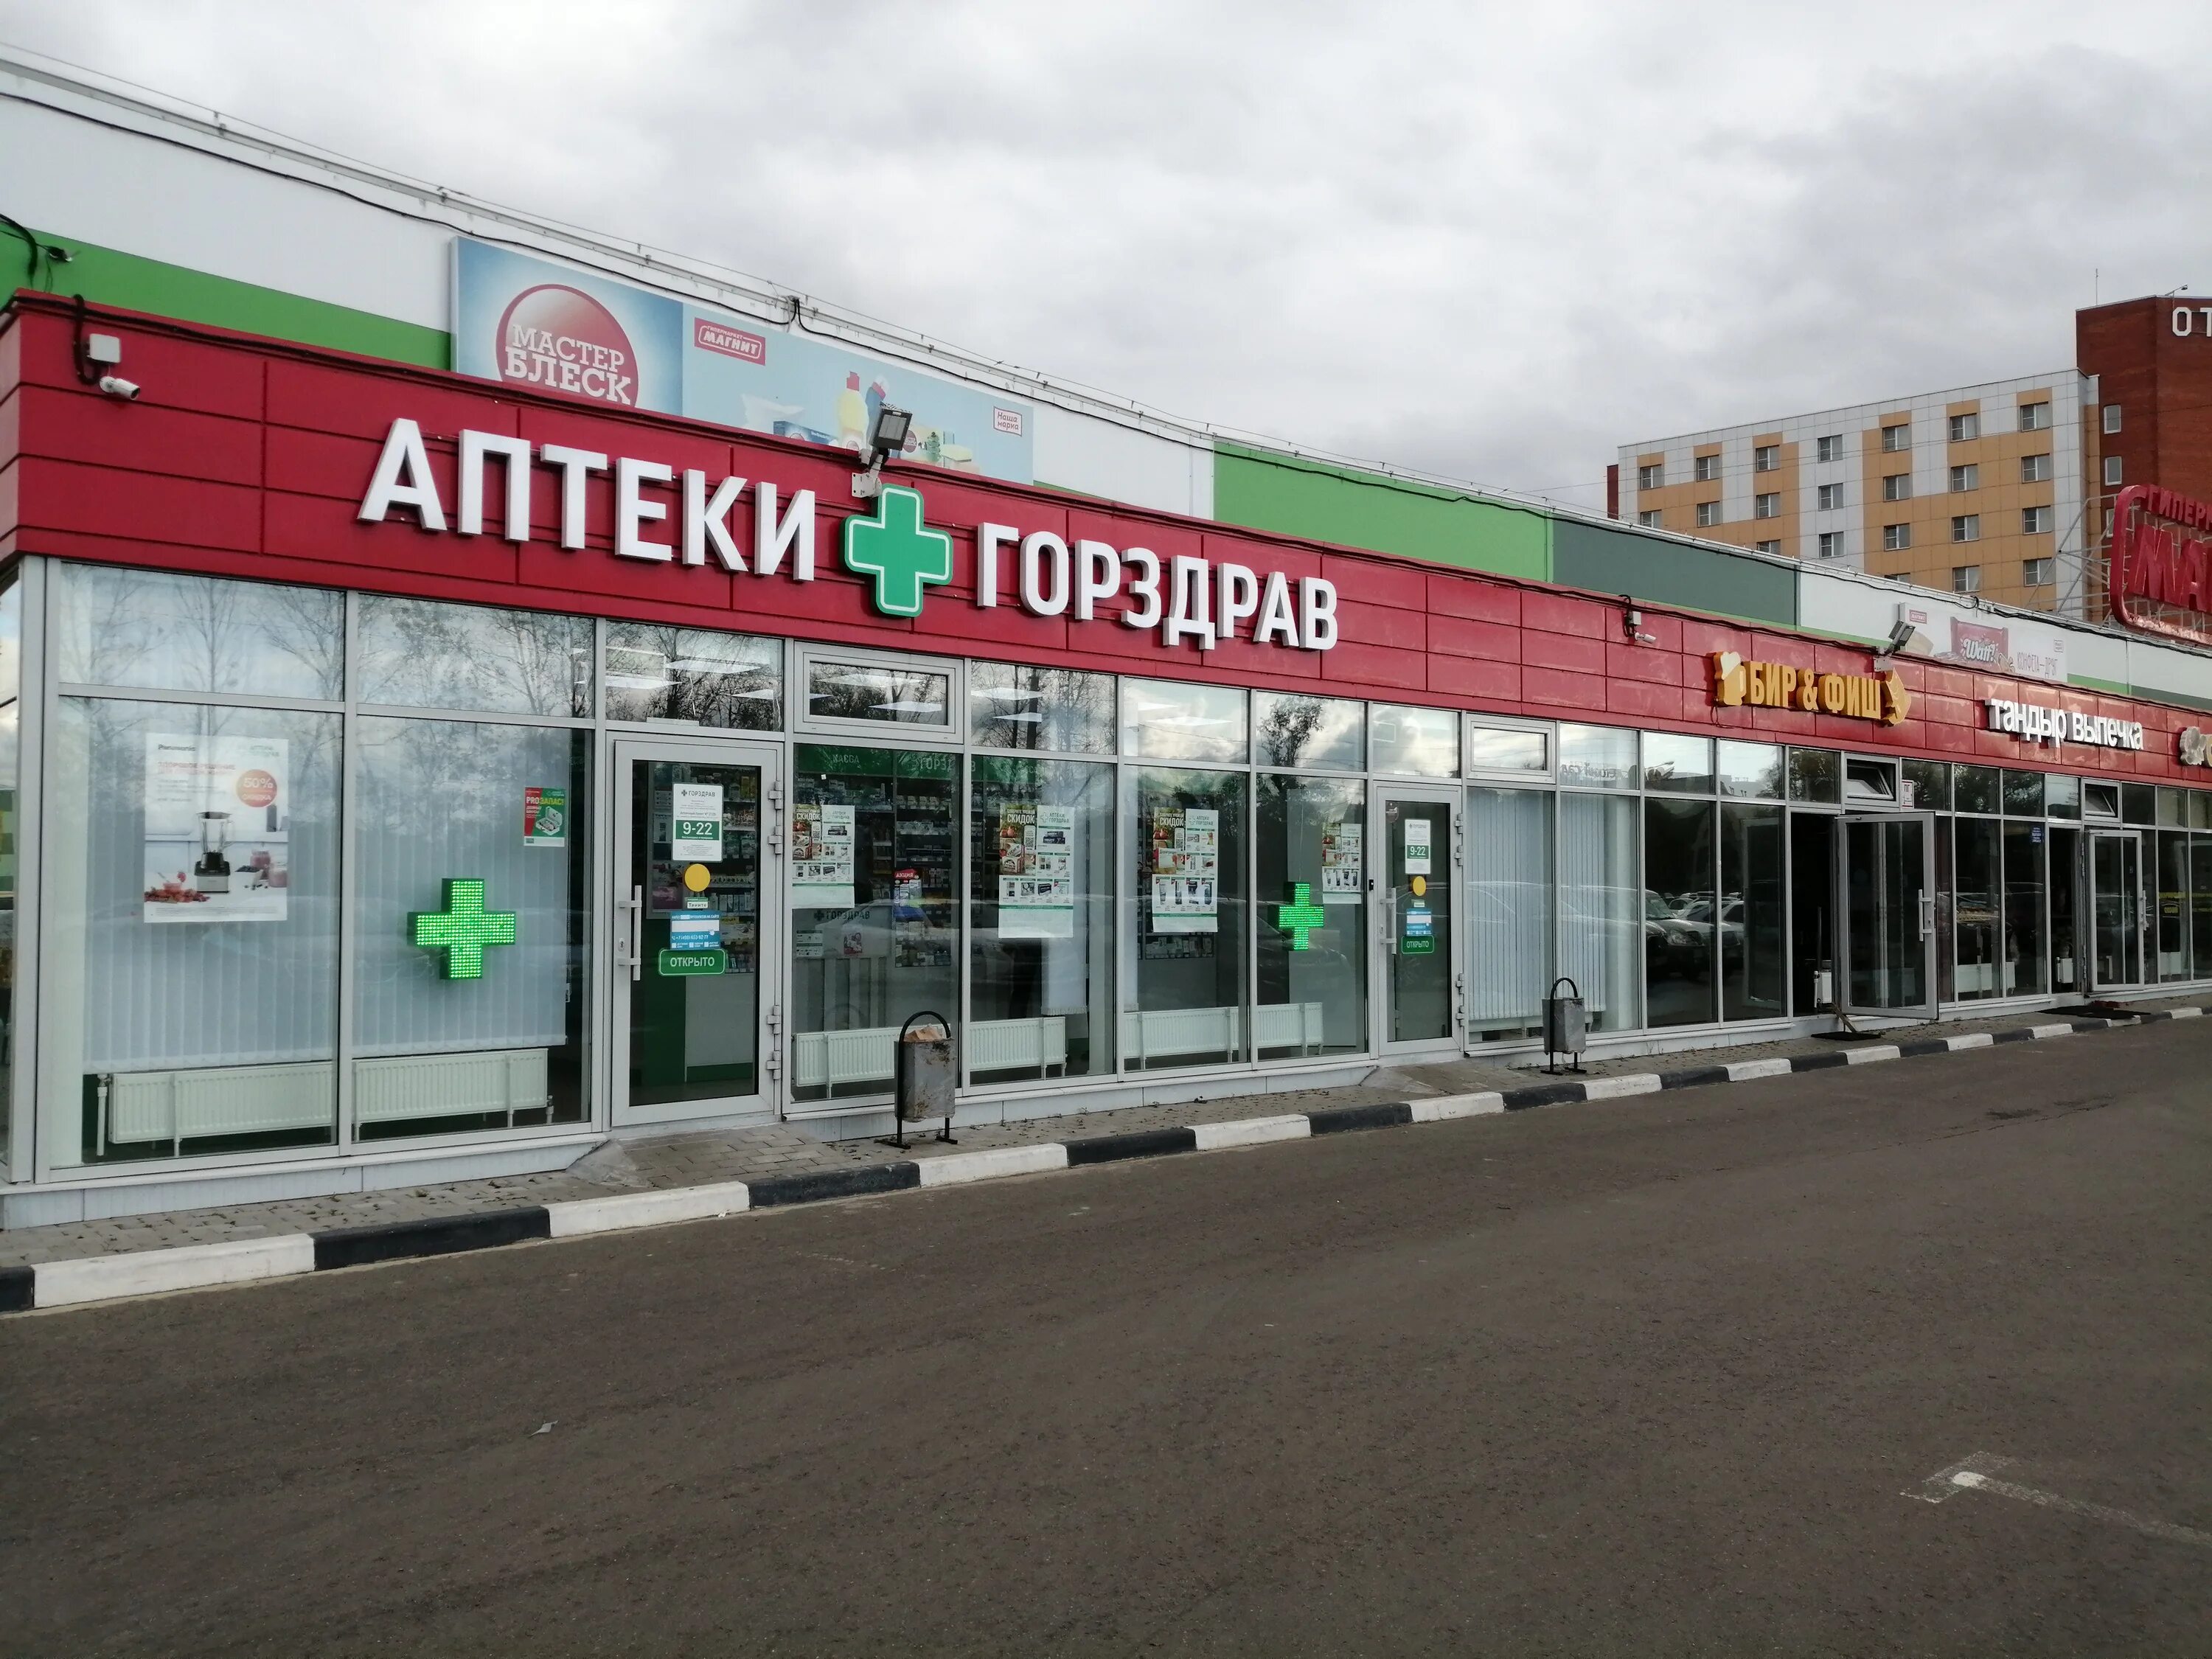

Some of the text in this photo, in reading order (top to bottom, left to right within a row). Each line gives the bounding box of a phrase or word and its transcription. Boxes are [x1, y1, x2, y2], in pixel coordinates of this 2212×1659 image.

[2172, 307, 2212, 337] ОТ
[707, 326, 743, 339] ГИПЕРМАРКЕТ
[512, 324, 625, 372] МАСТЕР
[703, 330, 758, 355] МАГНИТ
[505, 346, 631, 406] БЛЕСК
[998, 411, 1018, 422] Наша
[998, 421, 1019, 431] марка
[357, 417, 1338, 650] АПТЕКИ ГОРЗДРАВ
[2130, 524, 2212, 612] МА
[1745, 661, 1881, 720] БИР & ФИШ
[1989, 698, 2143, 750] тандыр выпечка
[243, 777, 274, 789] 50%
[796, 813, 820, 821] СКИДОК
[1007, 813, 1035, 824] СКИДОК
[1160, 817, 1184, 827] СКИДОК
[683, 822, 713, 835] 9-22
[1410, 846, 1426, 856] 9-22
[1406, 940, 1429, 948] ОТКРЫТО
[670, 957, 714, 967] ОТКРЫТО
